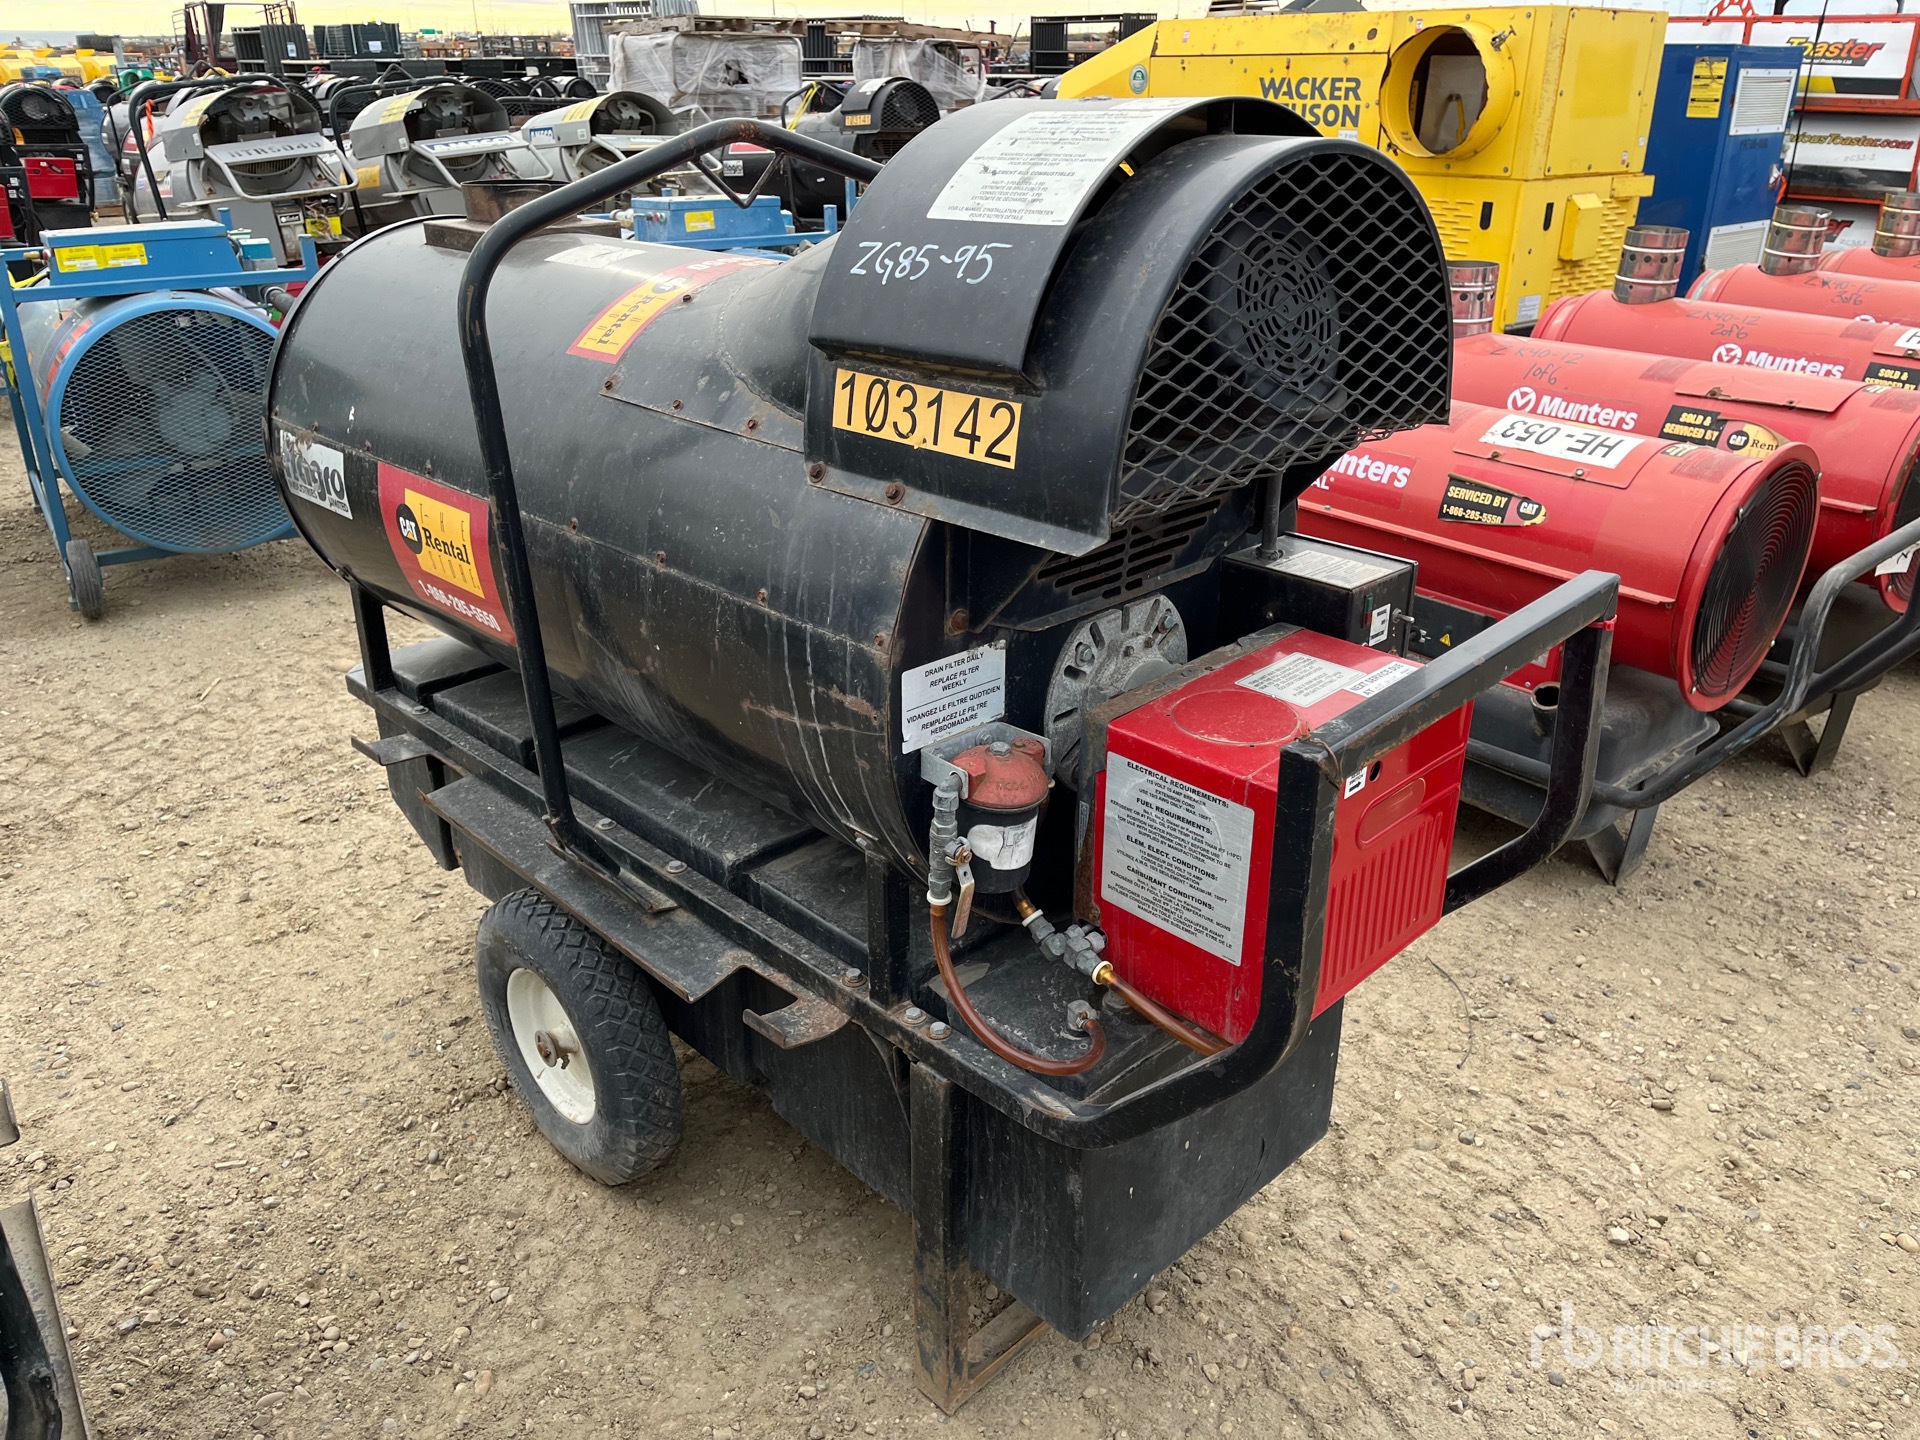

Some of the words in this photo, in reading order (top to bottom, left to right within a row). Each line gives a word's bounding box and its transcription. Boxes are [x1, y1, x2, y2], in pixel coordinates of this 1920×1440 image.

[1259, 77, 1362, 101] WACKER
[1281, 104, 1361, 128] USON
[850, 241, 1013, 285] ZG85-95
[596, 294, 656, 345] Rental
[1744, 350, 1845, 379] Munters
[1878, 368, 1901, 380] SOLD
[841, 373, 1016, 463] 103142
[1536, 395, 1639, 430] Munters
[1679, 412, 1704, 425] SOLD
[1663, 423, 1705, 439] SERVICED
[1704, 430, 1720, 441] BY
[1728, 435, 1748, 446] CAT
[1750, 439, 1779, 451] Rent
[1332, 453, 1411, 488] nters
[1448, 486, 1493, 505] SERVICED
[1493, 495, 1508, 508] BY
[1520, 502, 1539, 515] CAT
[1443, 504, 1502, 524] 1-866-285-5550
[399, 516, 418, 542] CAT
[421, 526, 471, 565] Rental
[924, 665, 943, 677] DRAIN
[944, 658, 964, 670] FILTER
[966, 651, 984, 663] DAILY
[929, 672, 957, 688] REPLACE
[959, 664, 979, 677] FILTER
[941, 677, 967, 692] WEEKLY
[906, 707, 937, 724] VIDANGEZ
[939, 704, 946, 712] LE
[947, 696, 967, 709] FILTRE
[969, 684, 1000, 701] QUOTIDIEN
[921, 712, 957, 731] REMPLACEZ
[958, 708, 965, 717] LE
[967, 700, 987, 713] FILTRE
[930, 712, 978, 735] HEBDOMADAIRE
[1127, 761, 1168, 784] ELECTRICAL
[1169, 778, 1228, 809] REQUIREMENTS:
[1154, 781, 1165, 790] VOLT
[1172, 789, 1182, 797] AMP
[1155, 789, 1180, 803] EXTENSION
[1181, 800, 1195, 809] CORD
[1169, 800, 1181, 809] ONLY
[1136, 797, 1153, 810] FUEL
[1155, 805, 1212, 835] REQUIREMENTS:
[1126, 813, 1146, 826] POSITION
[1147, 823, 1165, 834] HEATER
[1165, 831, 1189, 845] PROPERLY
[1190, 841, 1209, 854] BEFORE
[1136, 823, 1147, 832] WITH
[1148, 828, 1174, 844] DUCTWORK
[1188, 846, 1215, 862] DUCTWORK
[1216, 858, 1223, 866] TO
[1138, 829, 1159, 843] SUPPLIED
[1146, 815, 1158, 824] FUEL
[1166, 824, 1176, 832] FOR
[1191, 834, 1203, 844] LESS
[1204, 840, 1217, 850] THAN
[1164, 865, 1199, 886] PROLONGATION
[1171, 854, 1218, 881] CONDITIONS:
[1173, 865, 1186, 874] VOLT
[1192, 873, 1202, 882] AMP
[1126, 864, 1166, 889] CARBURANT
[1168, 884, 1214, 912] CONDITIONS:
